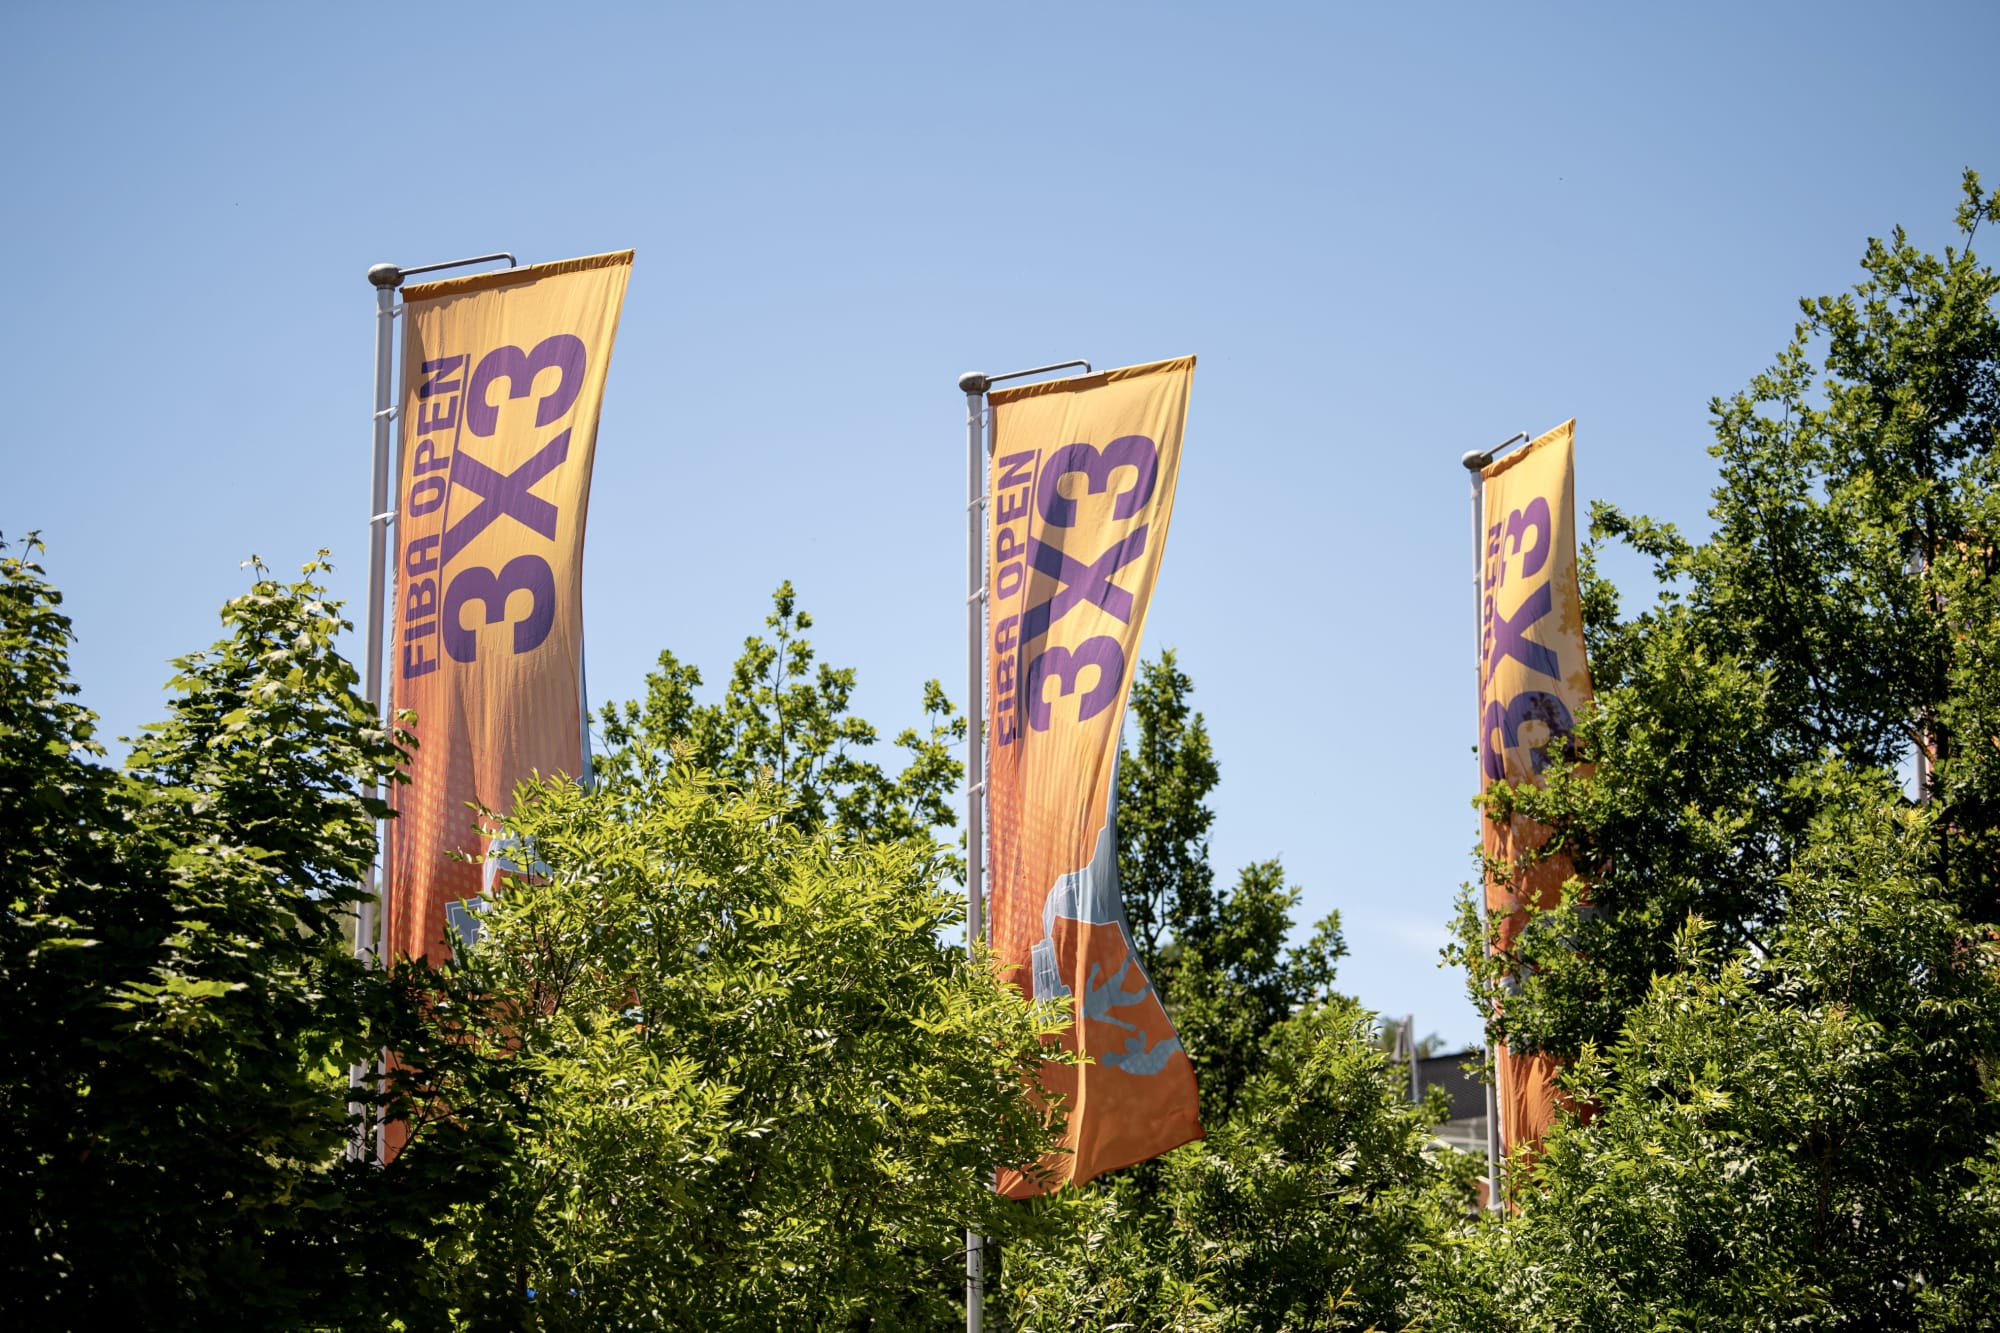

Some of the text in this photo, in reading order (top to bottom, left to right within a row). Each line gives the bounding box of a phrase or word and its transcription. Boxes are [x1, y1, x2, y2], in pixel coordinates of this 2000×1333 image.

[403, 354, 464, 679] FIBA OPEN
[442, 334, 587, 664] 3X3
[994, 449, 1036, 746] FIBA OPEN
[1018, 434, 1159, 733] 3X3
